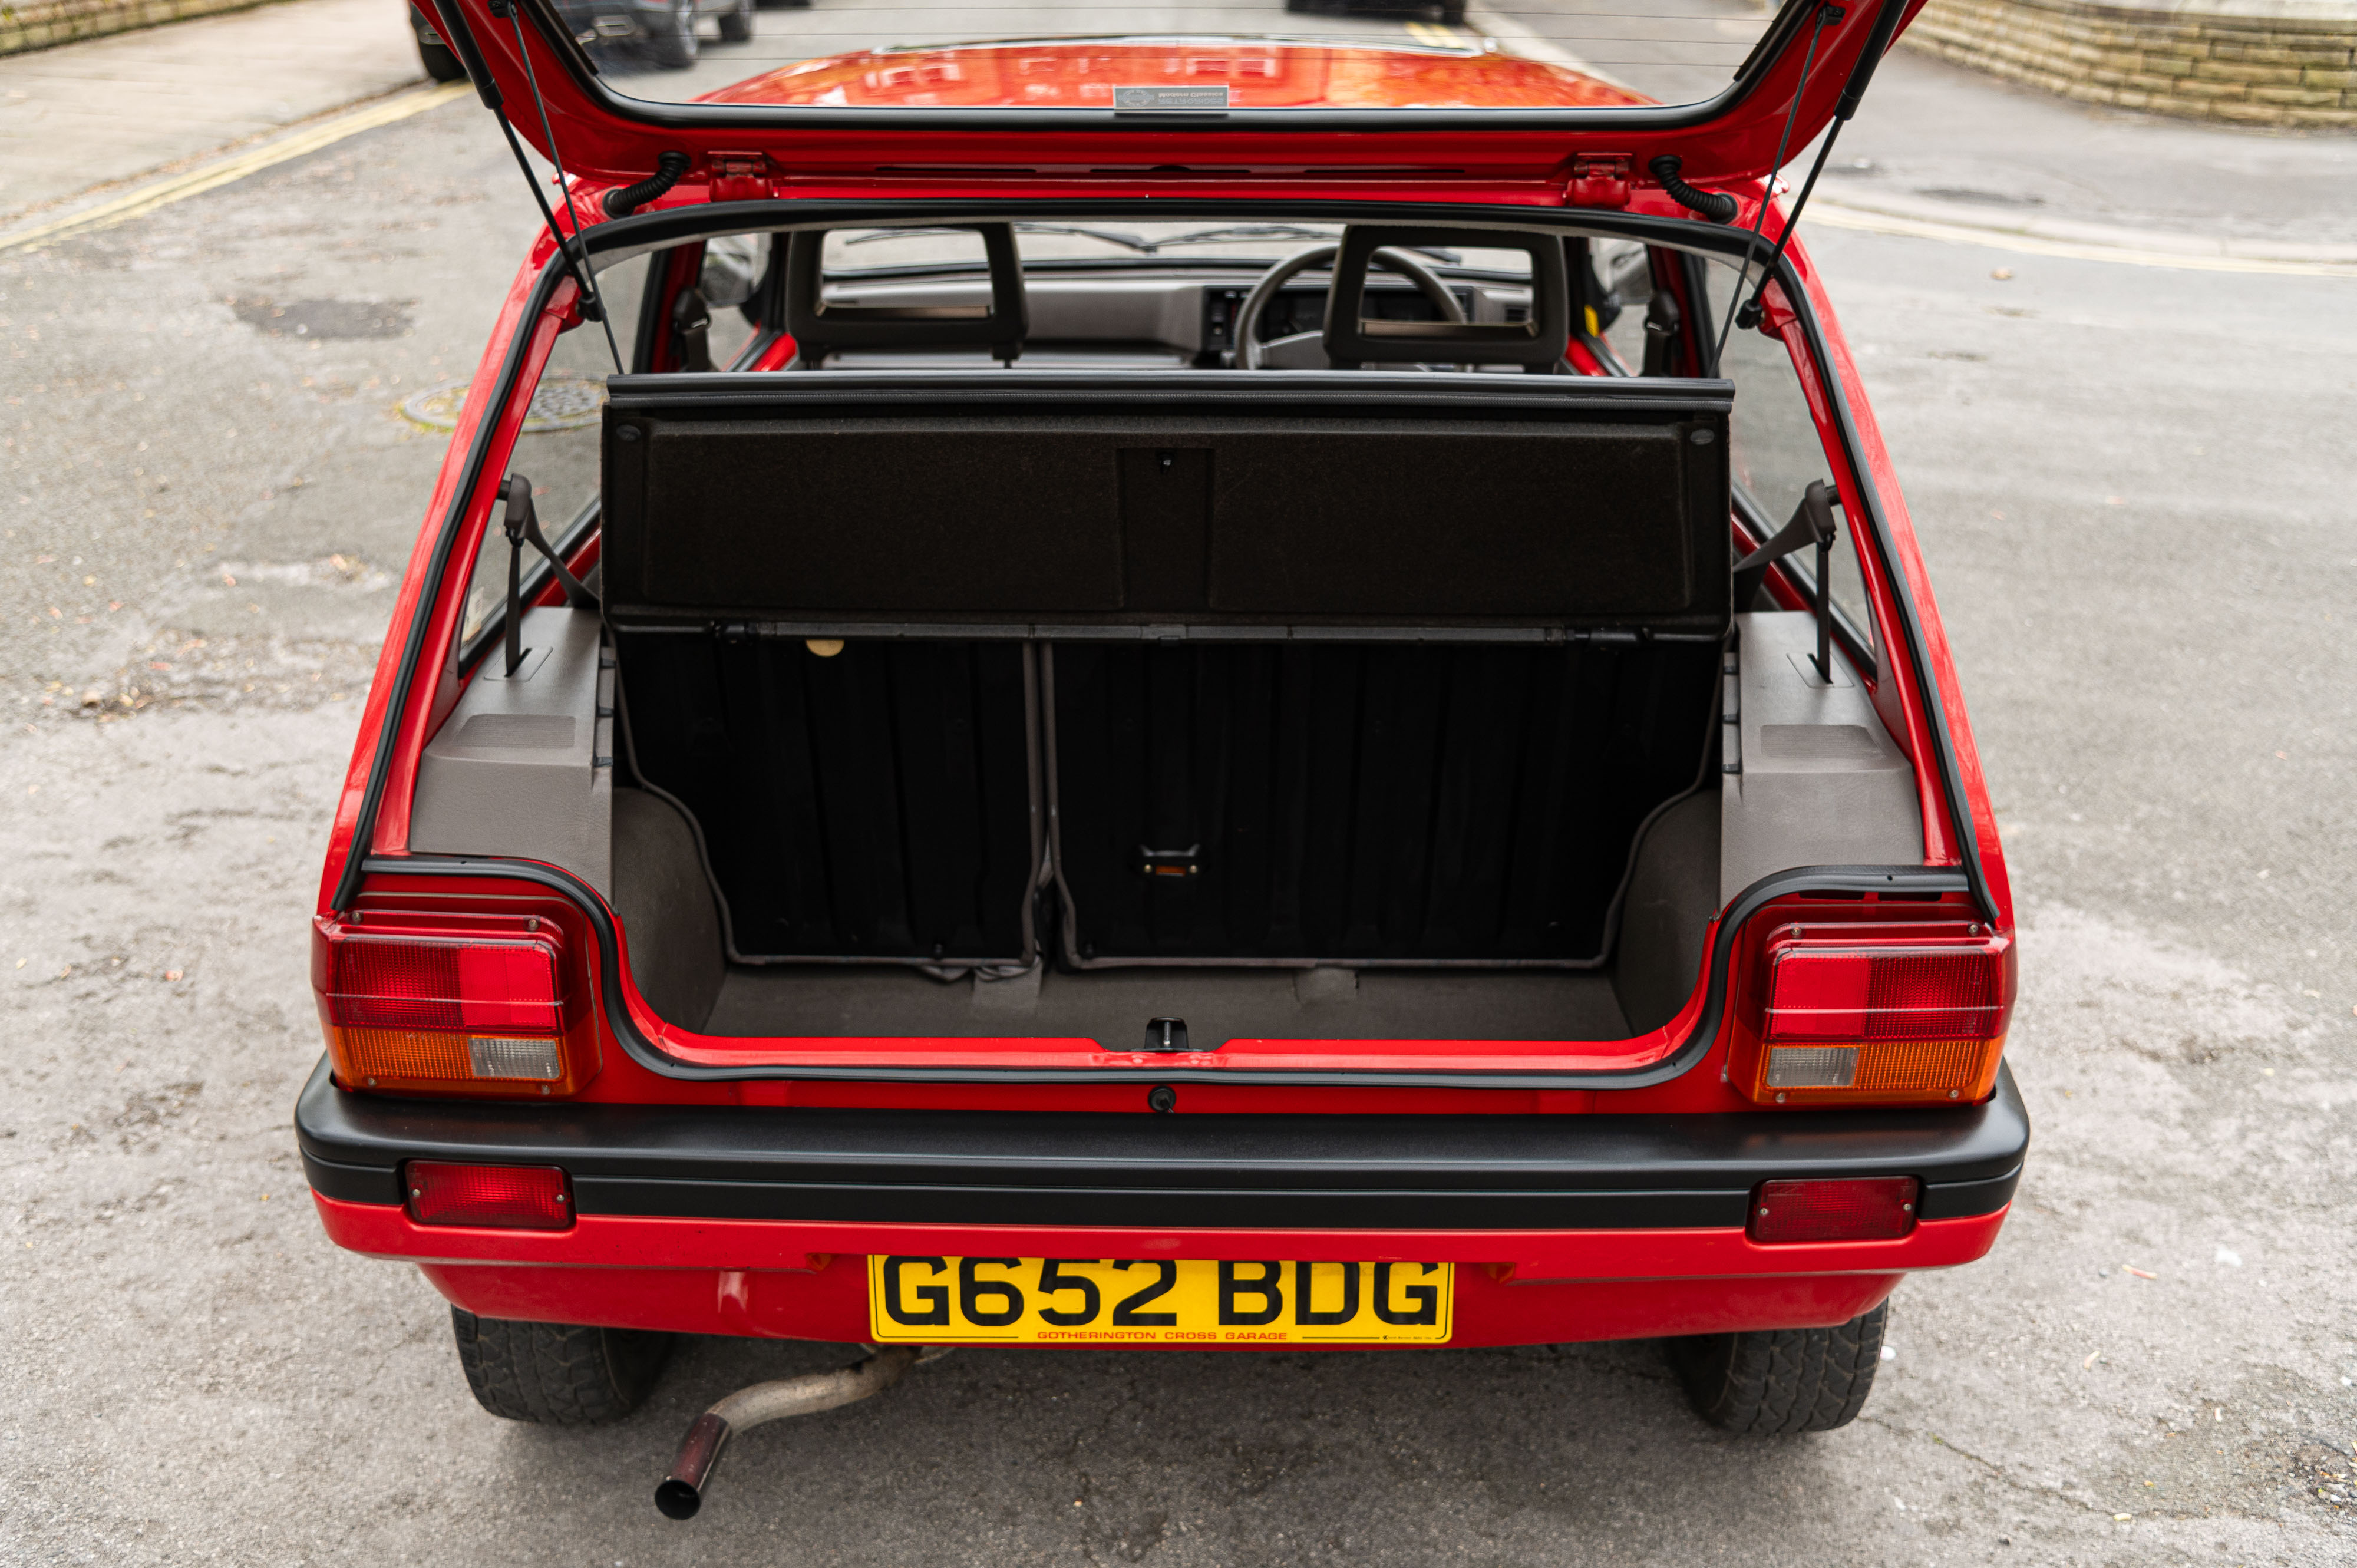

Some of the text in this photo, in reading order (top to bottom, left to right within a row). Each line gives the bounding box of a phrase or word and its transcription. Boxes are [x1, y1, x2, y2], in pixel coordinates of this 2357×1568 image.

[883, 1255, 1438, 1326] G652 BDG
[1038, 1331, 1156, 1339] GOTHERINGTON
